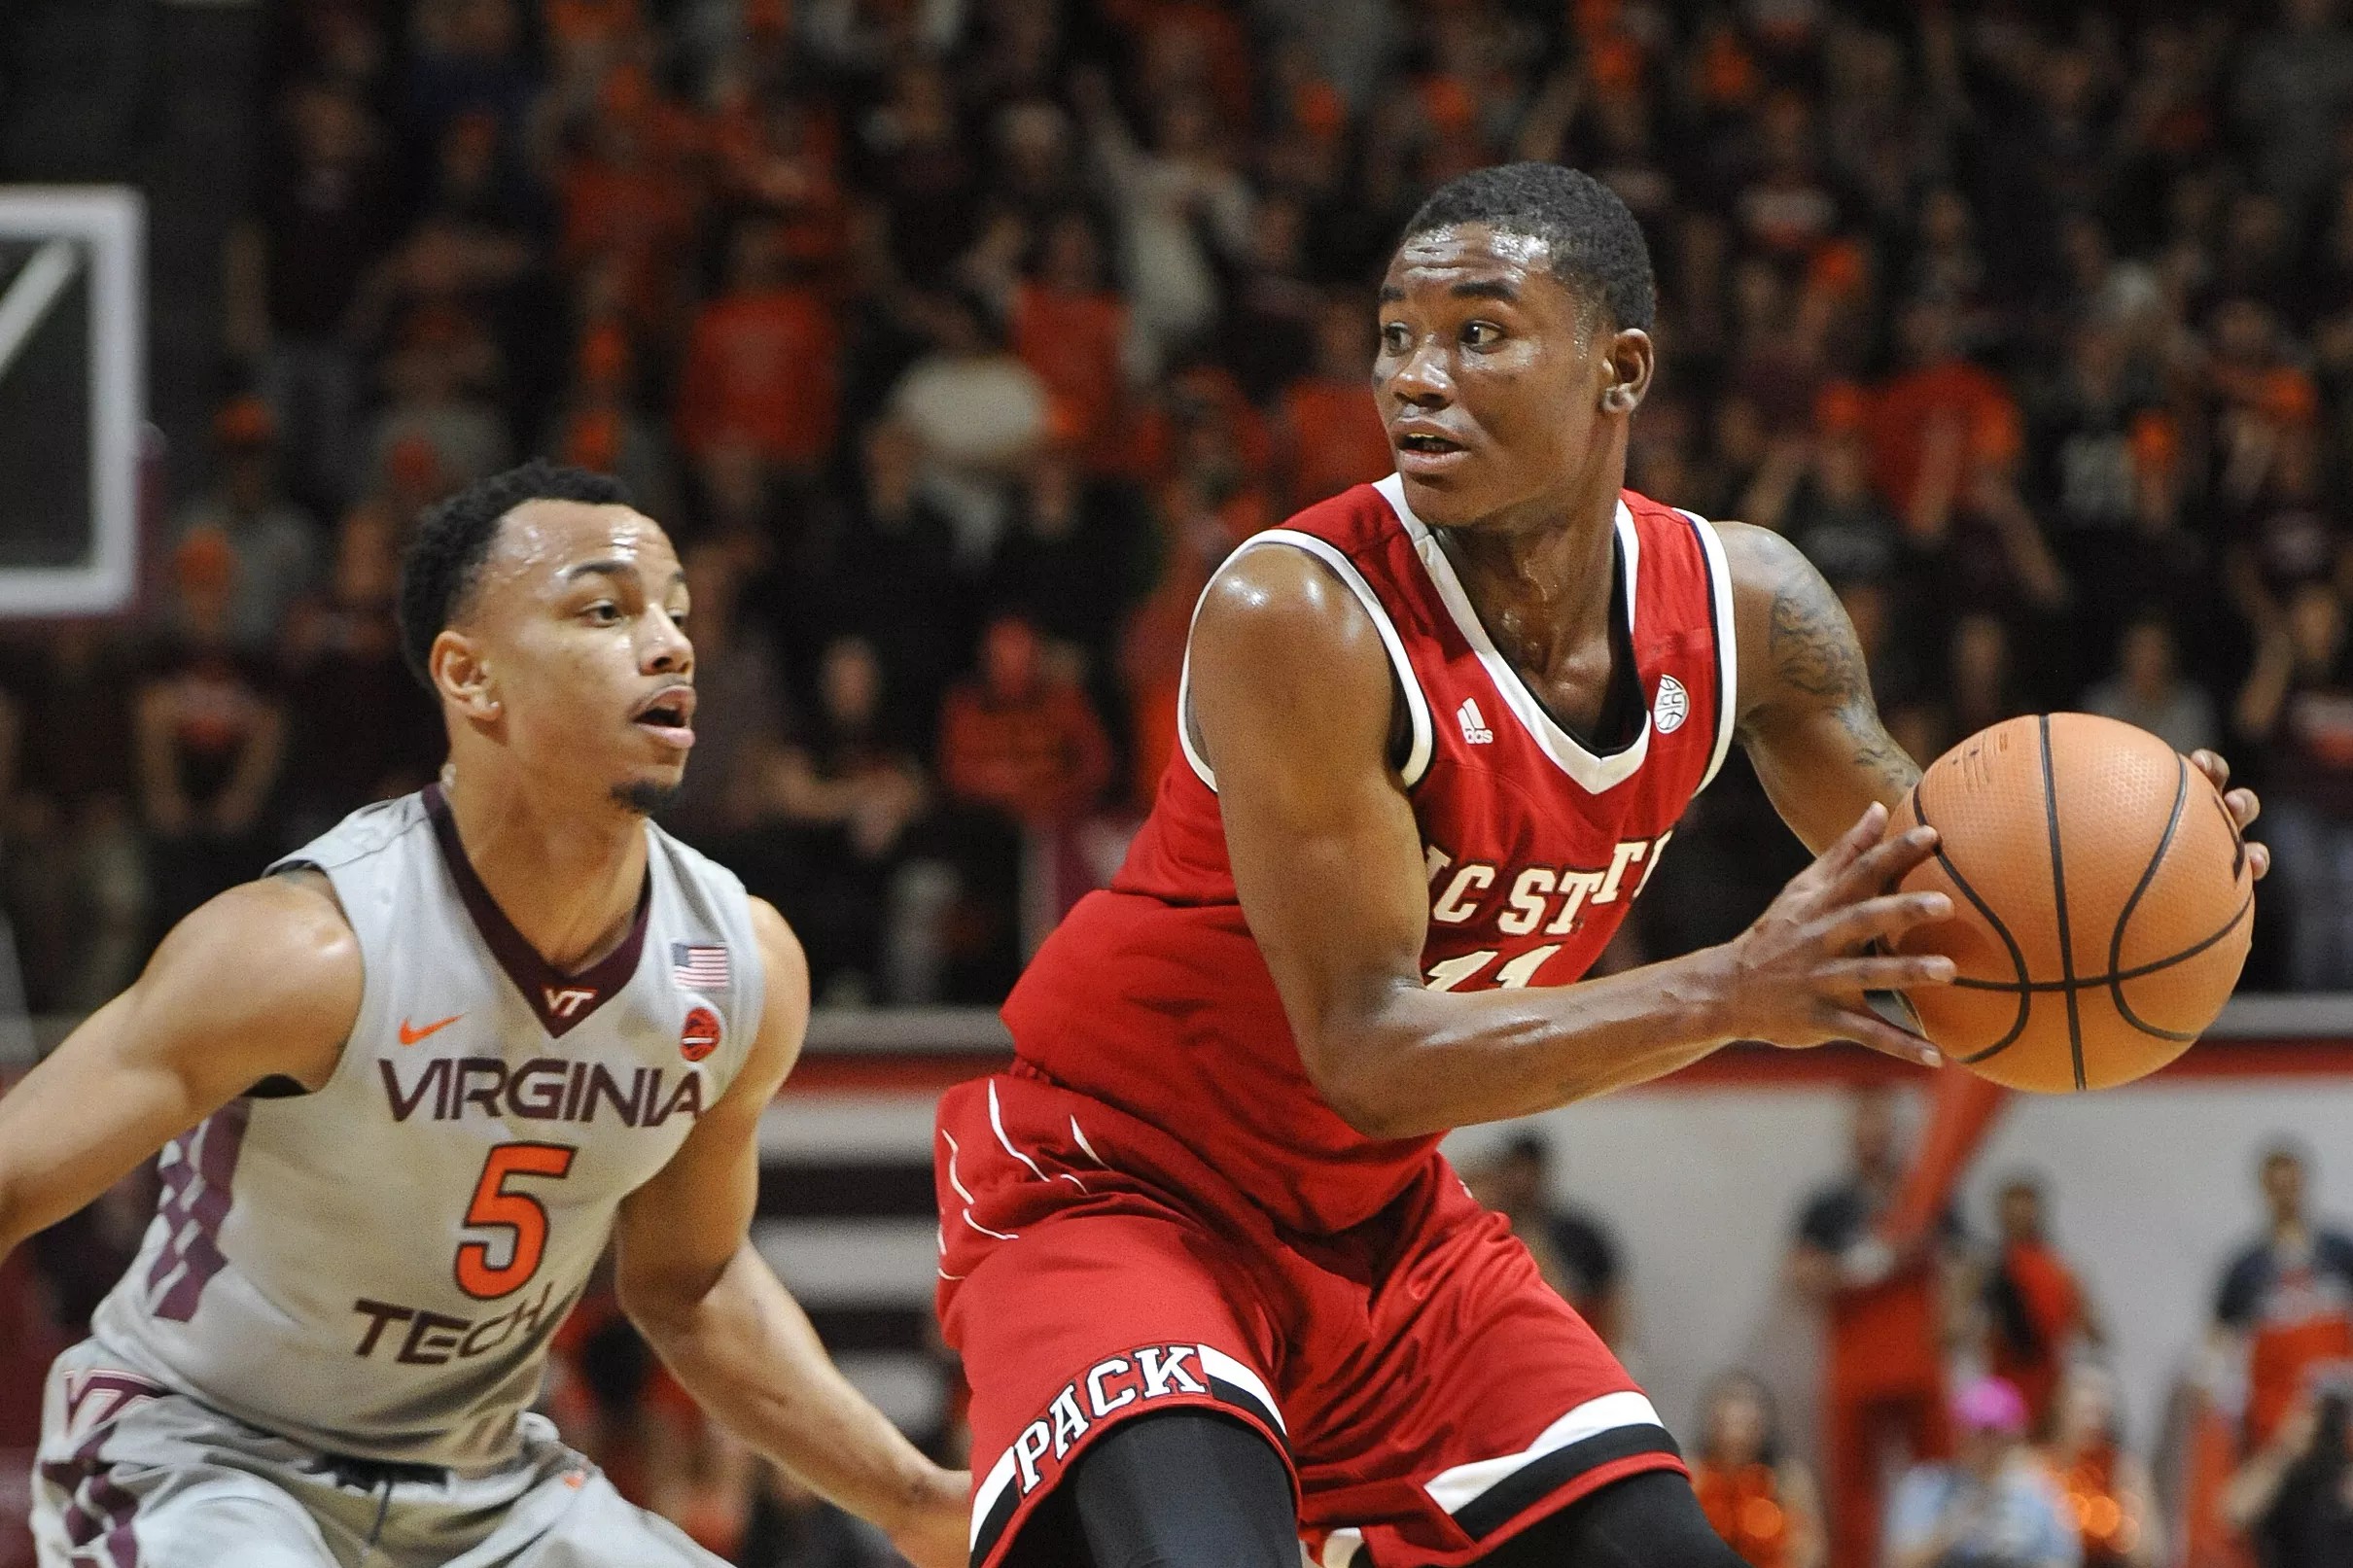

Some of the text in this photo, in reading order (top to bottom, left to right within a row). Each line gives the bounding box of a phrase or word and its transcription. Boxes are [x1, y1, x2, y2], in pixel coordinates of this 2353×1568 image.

[543, 986, 595, 1017] VT
[378, 1058, 703, 1128] VIRGINIA
[454, 1141, 578, 1300] 5
[354, 1281, 554, 1364] TECH
[1014, 1345, 1207, 1495] PACK
